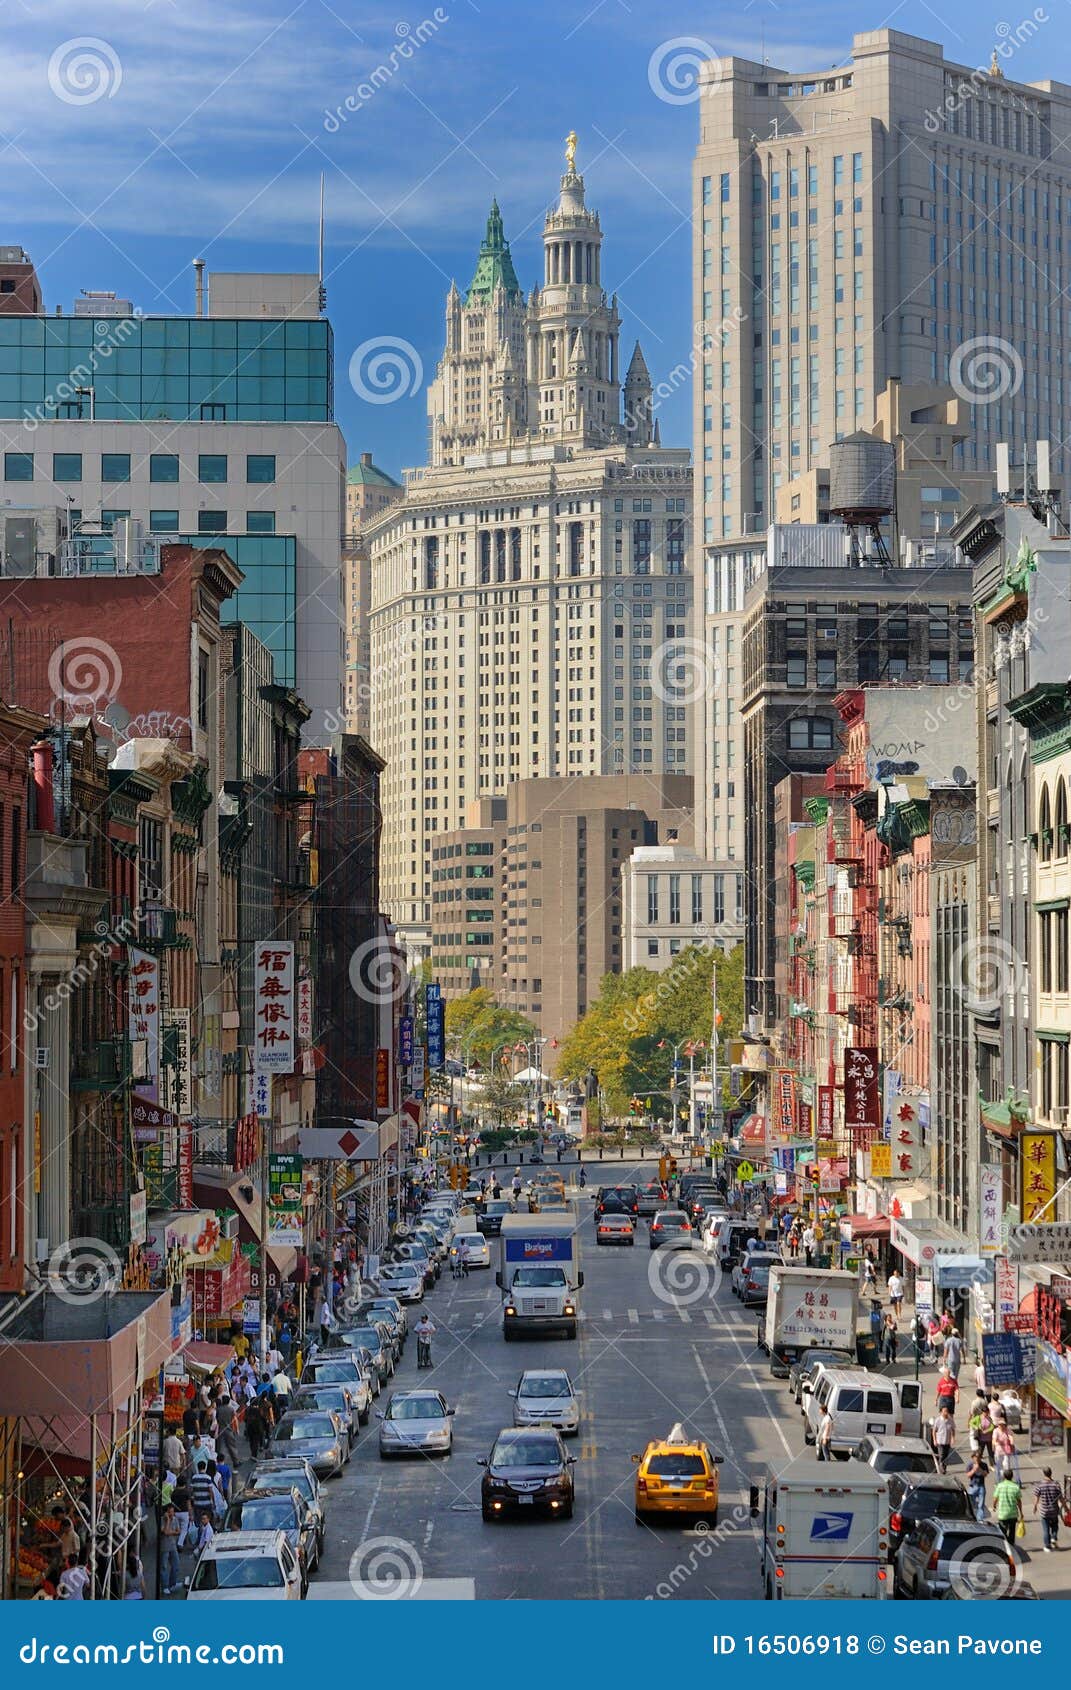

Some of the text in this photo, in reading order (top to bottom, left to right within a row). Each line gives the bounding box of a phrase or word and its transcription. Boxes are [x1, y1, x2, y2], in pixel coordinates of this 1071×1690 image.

[257, 950, 291, 1047] 福華傢俬
[897, 1102, 915, 1172] 安之家
[983, 1189, 997, 1242] 西餅屋
[524, 1243, 552, 1253] Budget
